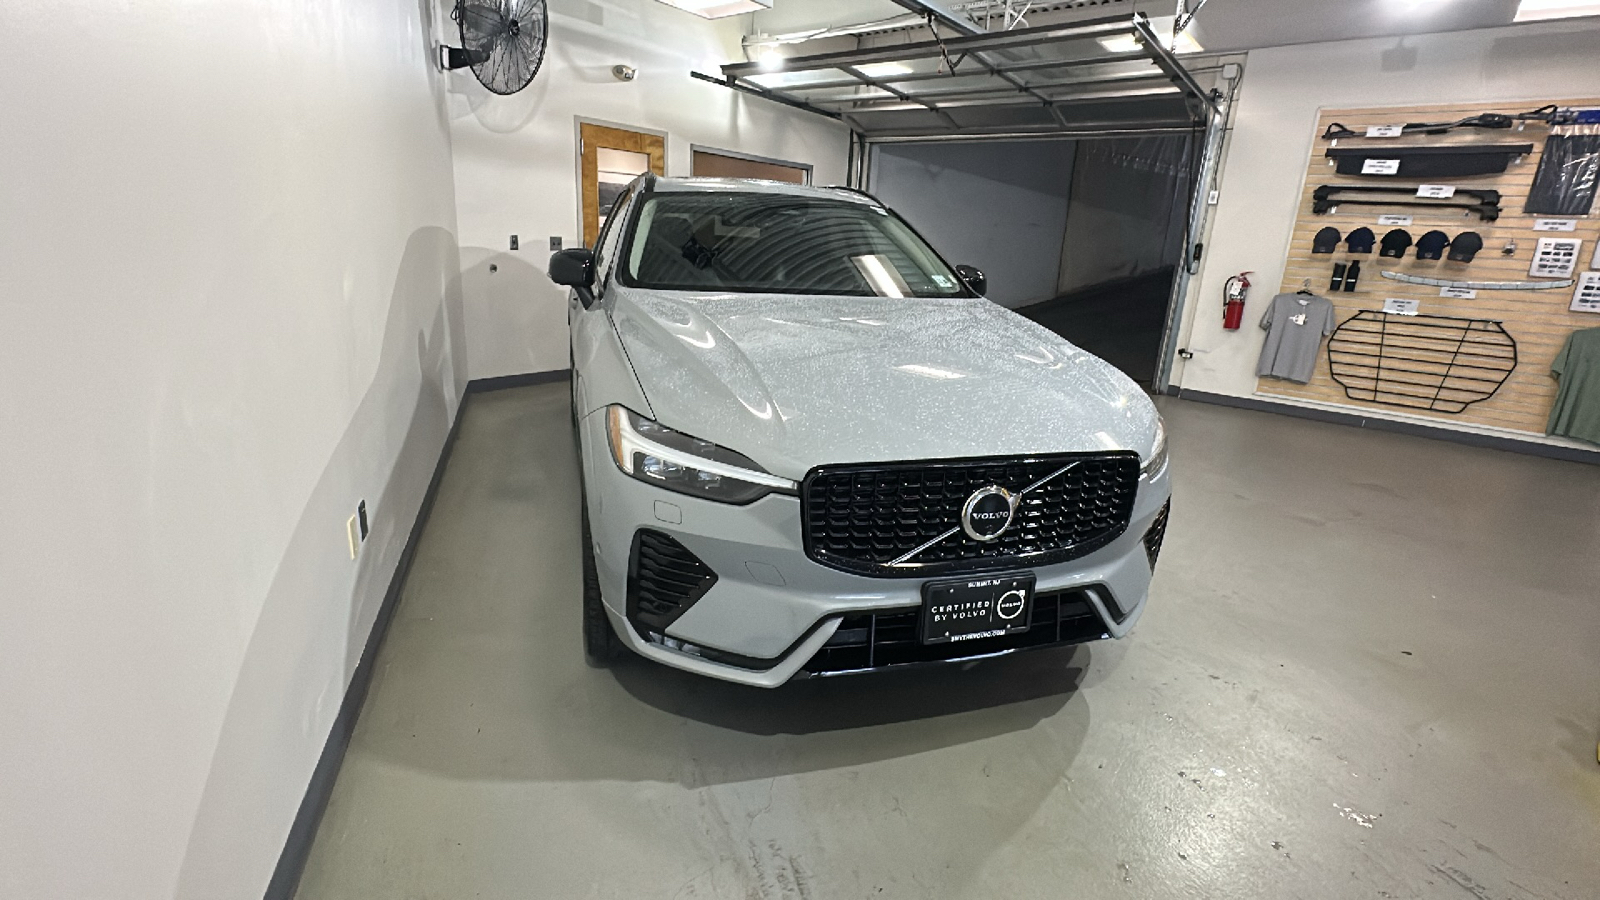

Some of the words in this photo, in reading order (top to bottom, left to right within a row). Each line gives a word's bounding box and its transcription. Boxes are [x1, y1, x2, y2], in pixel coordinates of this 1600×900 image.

[972, 511, 1009, 520] VOLVO
[931, 601, 990, 613] CERTIFIED
[934, 614, 948, 622] BY
[952, 609, 986, 619] VOLVO
